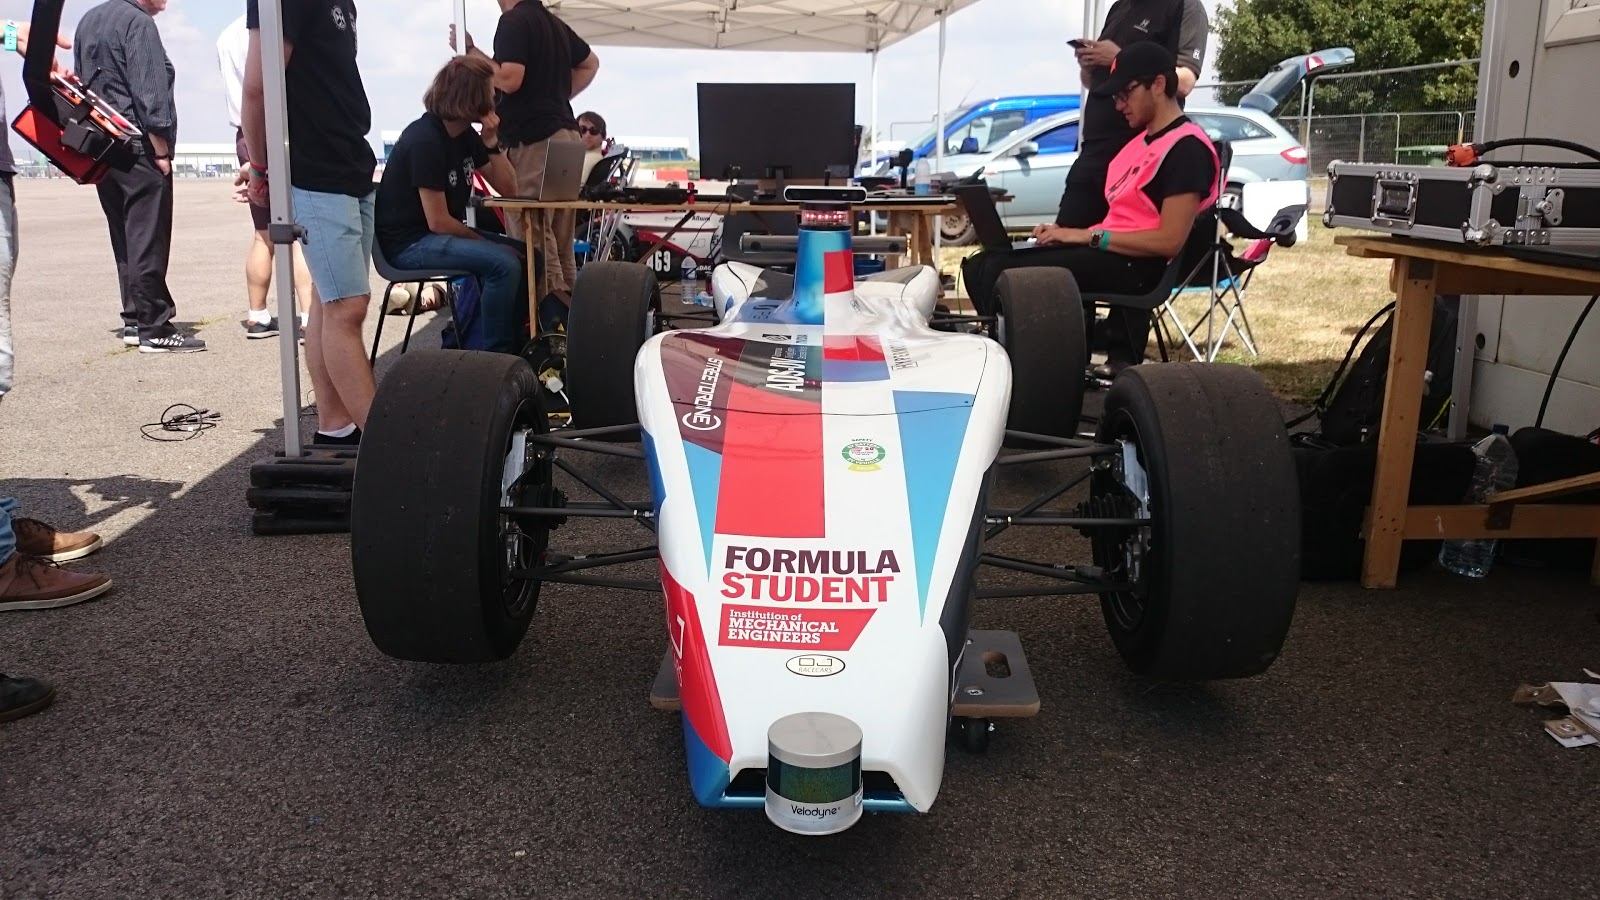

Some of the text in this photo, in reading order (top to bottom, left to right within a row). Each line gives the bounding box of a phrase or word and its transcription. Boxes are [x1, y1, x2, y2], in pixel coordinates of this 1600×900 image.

[765, 356, 807, 392] ADS-DV
[692, 357, 724, 425] STREETDRONE
[725, 545, 901, 574] FORMULA
[720, 571, 894, 603] STUDENT
[728, 617, 839, 633] MECHANICAL
[729, 609, 802, 621] Institution of
[727, 629, 821, 644] ENGINEERS
[791, 804, 837, 819] Velodyne
